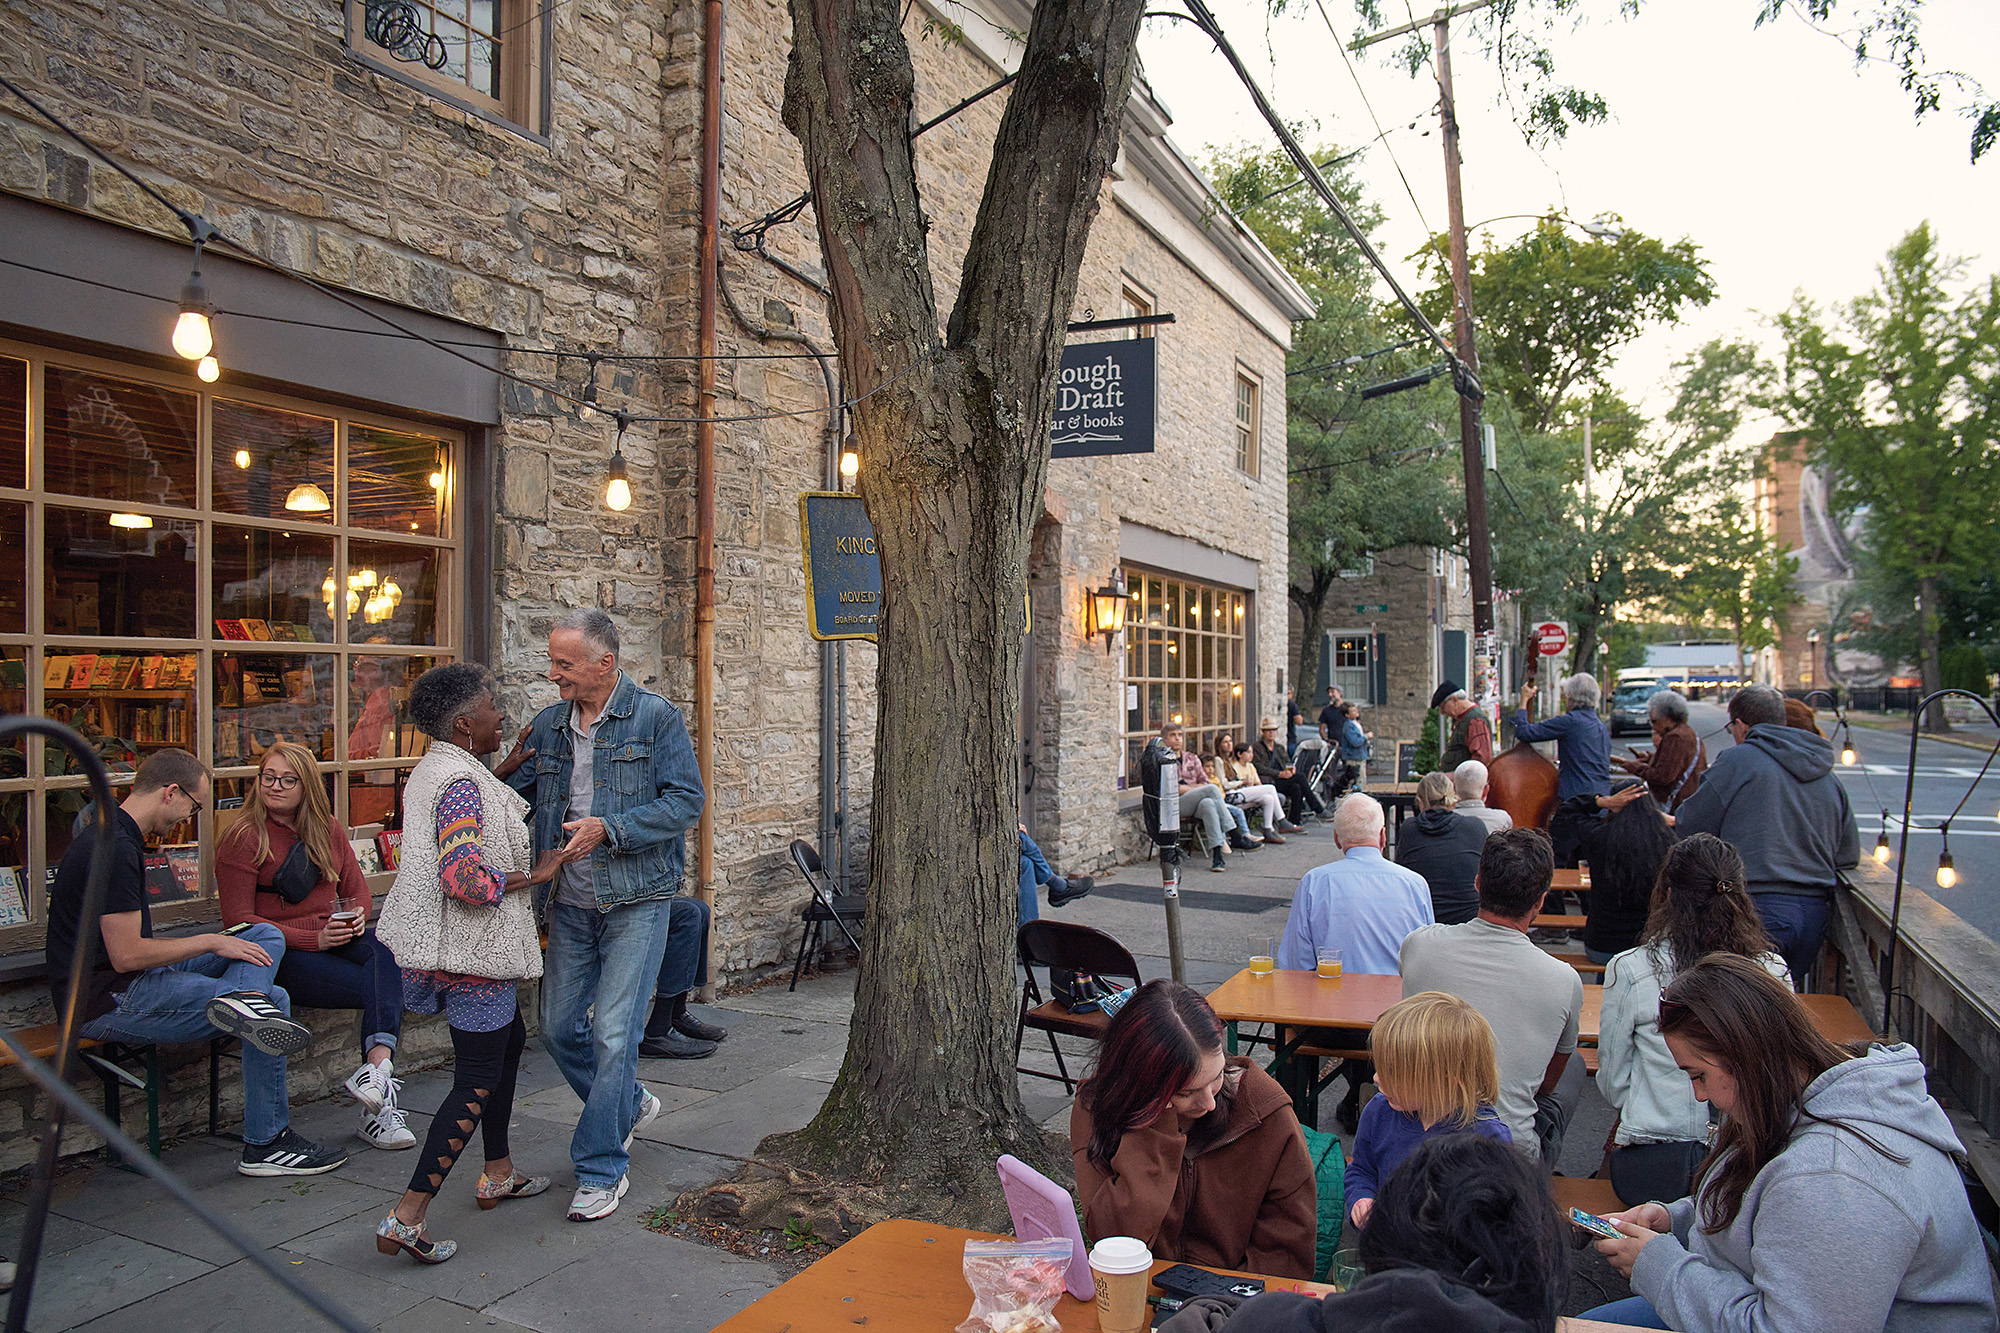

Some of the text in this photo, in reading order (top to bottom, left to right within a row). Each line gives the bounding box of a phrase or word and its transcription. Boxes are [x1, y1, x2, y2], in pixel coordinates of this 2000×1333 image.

[1057, 355, 1122, 390] ough
[1059, 381, 1124, 411] Draft
[1051, 412, 1124, 431] ar & books
[839, 591, 876, 603] MOVED
[834, 615, 858, 624] BOARD
[859, 615, 867, 624] OF
[1540, 643, 1561, 651] ENTER
